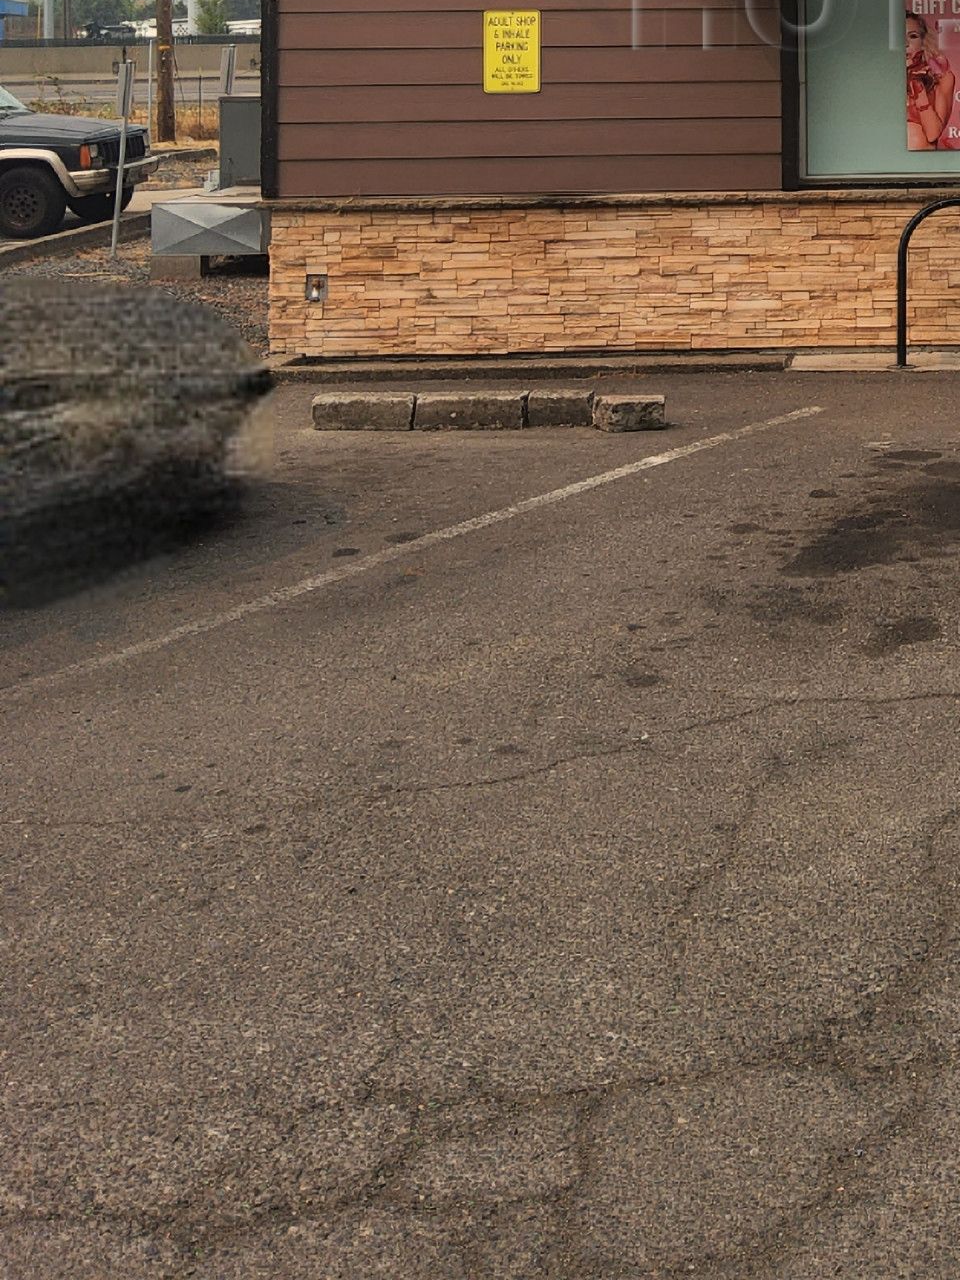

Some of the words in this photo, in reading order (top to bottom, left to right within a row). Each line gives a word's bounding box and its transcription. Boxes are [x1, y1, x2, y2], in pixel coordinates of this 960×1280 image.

[488, 16, 512, 26] ADULT
[516, 16, 536, 26] SHOP
[496, 41, 529, 51] PARKING
[502, 54, 522, 64] ONLY
